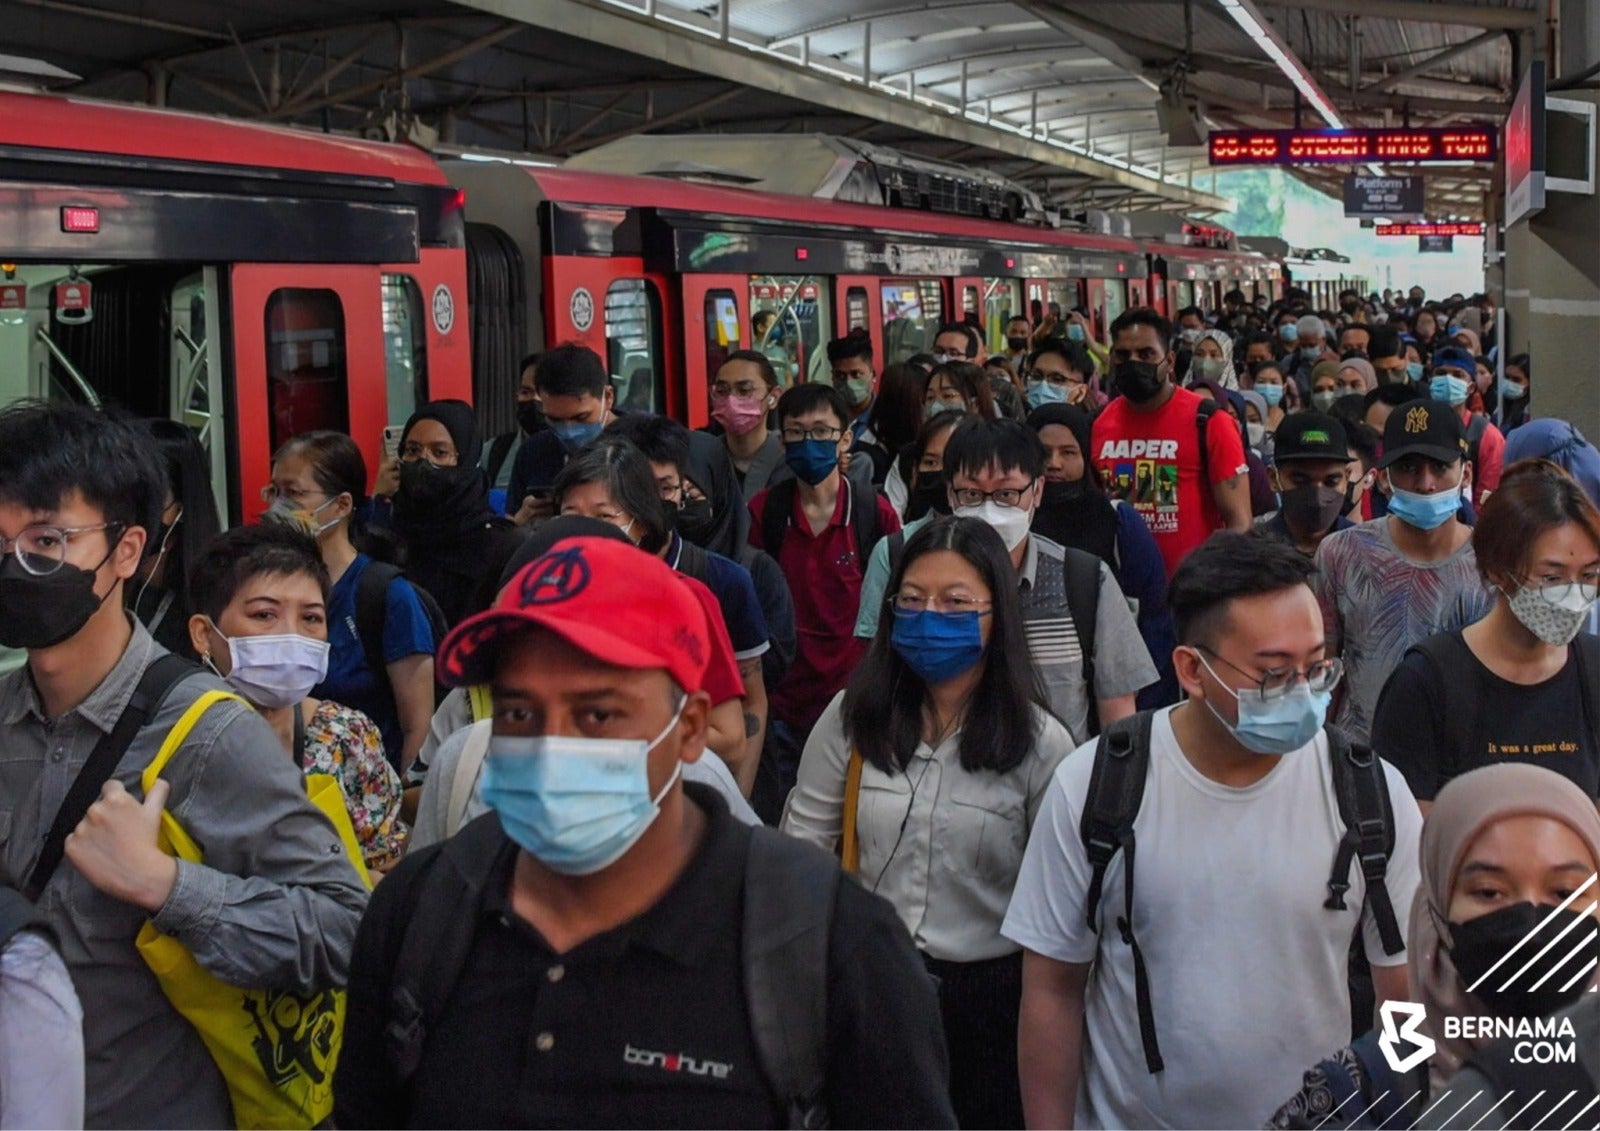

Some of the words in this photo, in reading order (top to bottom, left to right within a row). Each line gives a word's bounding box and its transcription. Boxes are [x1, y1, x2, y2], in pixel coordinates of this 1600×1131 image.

[1355, 177, 1403, 189] Platform
[1100, 439, 1178, 460] AAPER
[1157, 512, 1178, 523] ALL
[1488, 742, 1497, 753] It
[1500, 745, 1520, 753] was
[1532, 743, 1557, 755] great
